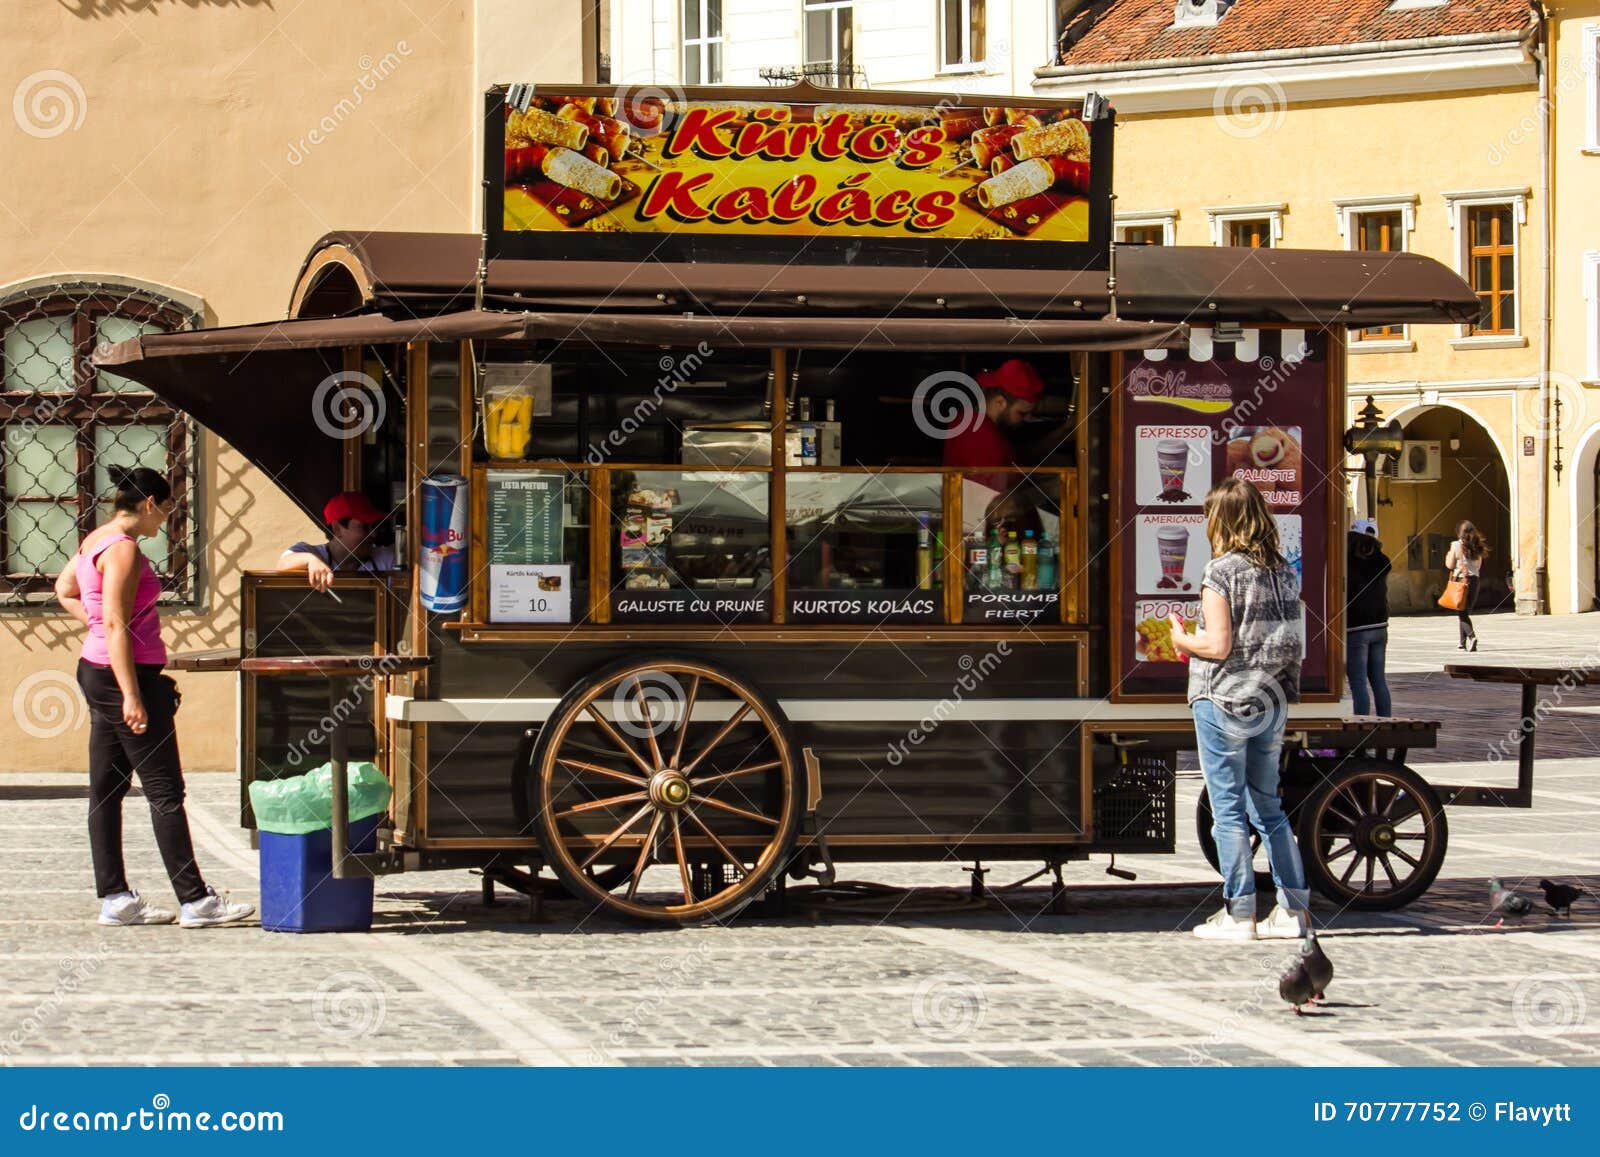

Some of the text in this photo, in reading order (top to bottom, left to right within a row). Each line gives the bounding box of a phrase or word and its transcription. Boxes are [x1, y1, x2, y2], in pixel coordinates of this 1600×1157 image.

[664, 107, 947, 169] Kürtös
[636, 171, 956, 230] Kalács
[1140, 427, 1208, 438] EXPRESSO
[1232, 468, 1297, 482] GALUSTE
[1260, 491, 1302, 505] RUNE
[1143, 515, 1204, 524] AMERICANO
[529, 598, 547, 612] 10
[968, 593, 1058, 603] PORUMB
[617, 599, 765, 613] GALUSTE CU PRUNE
[792, 600, 934, 614] KURTOS KOLACS
[1142, 603, 1199, 619] PORU
[985, 609, 1044, 618] FIERT
